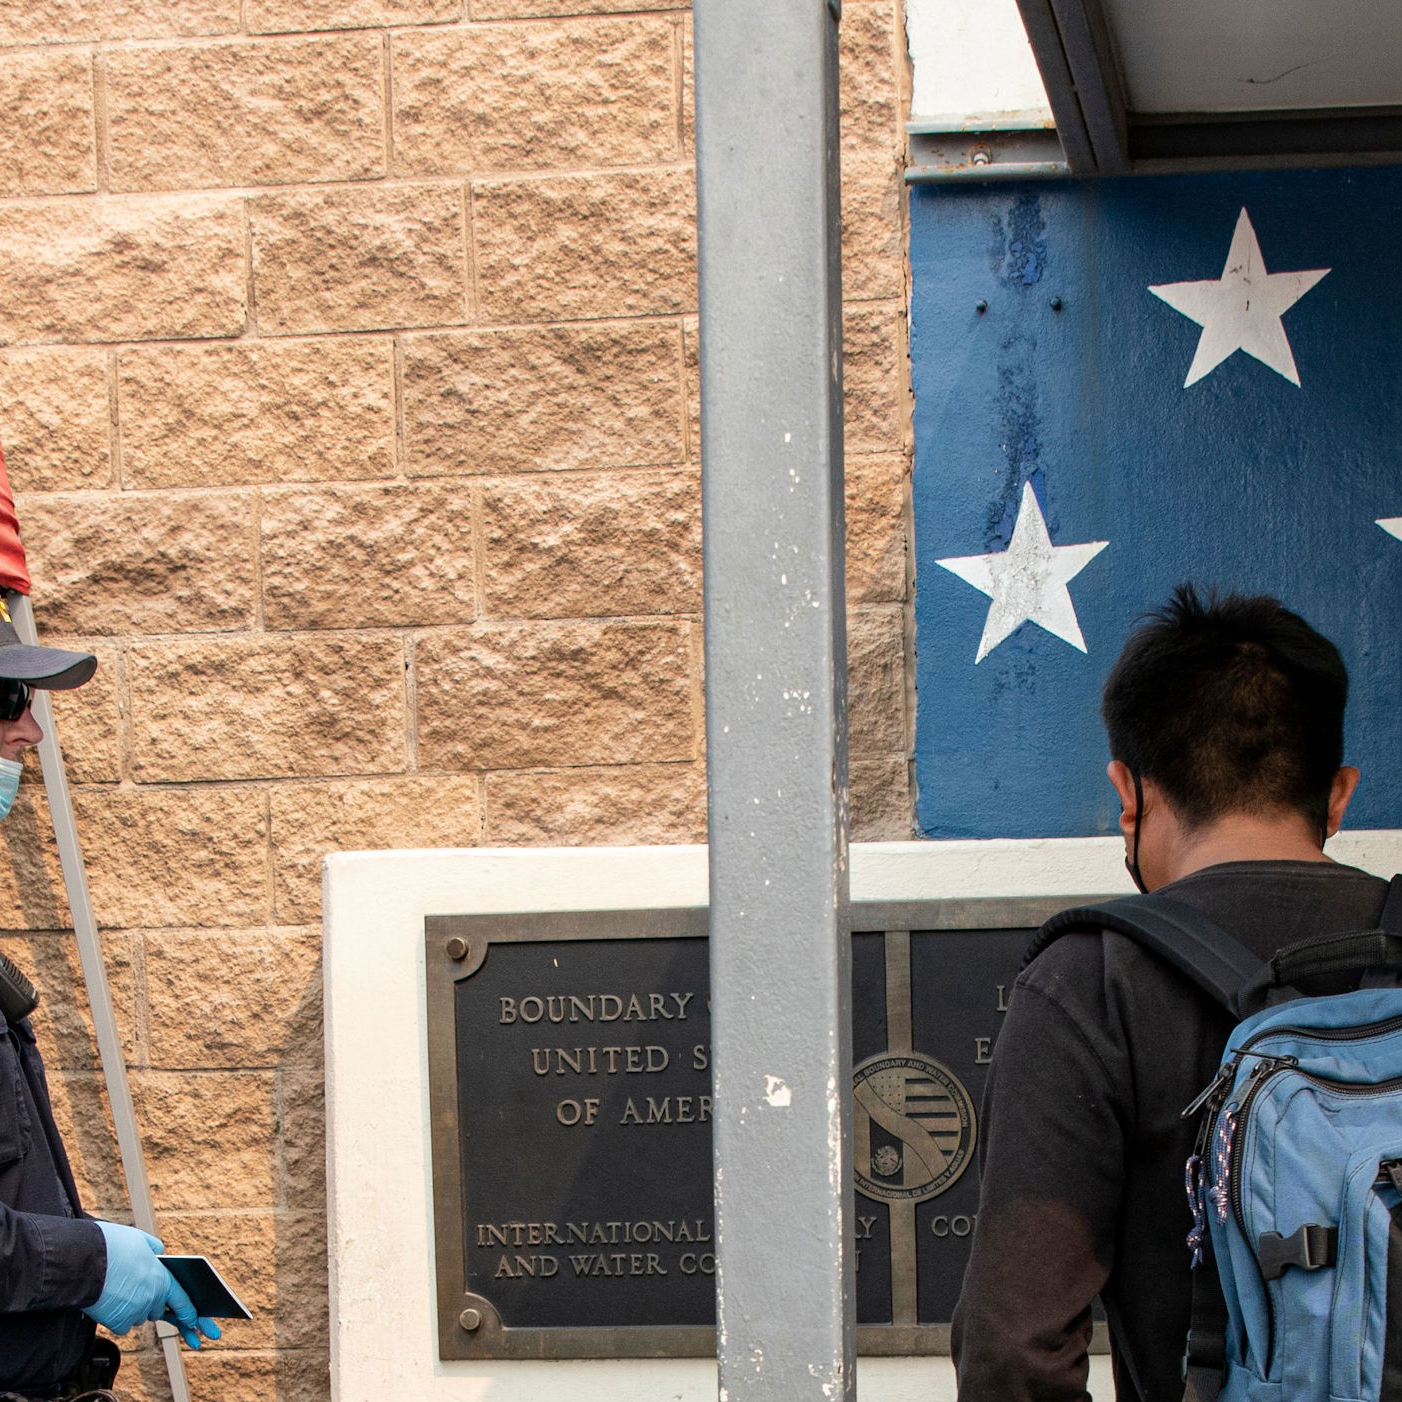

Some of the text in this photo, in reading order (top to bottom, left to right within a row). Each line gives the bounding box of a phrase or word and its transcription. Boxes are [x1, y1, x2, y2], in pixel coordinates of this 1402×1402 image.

[499, 992, 694, 1025] BOUNDARY
[531, 1045, 670, 1076] UNITED
[864, 1058, 907, 1077] BOUNDARY
[907, 1060, 925, 1071] AND
[556, 1096, 713, 1127] OF AMER
[477, 1220, 711, 1247] INTERNATIONAL
[494, 1254, 559, 1278] AND
[569, 1253, 668, 1276] WATER
